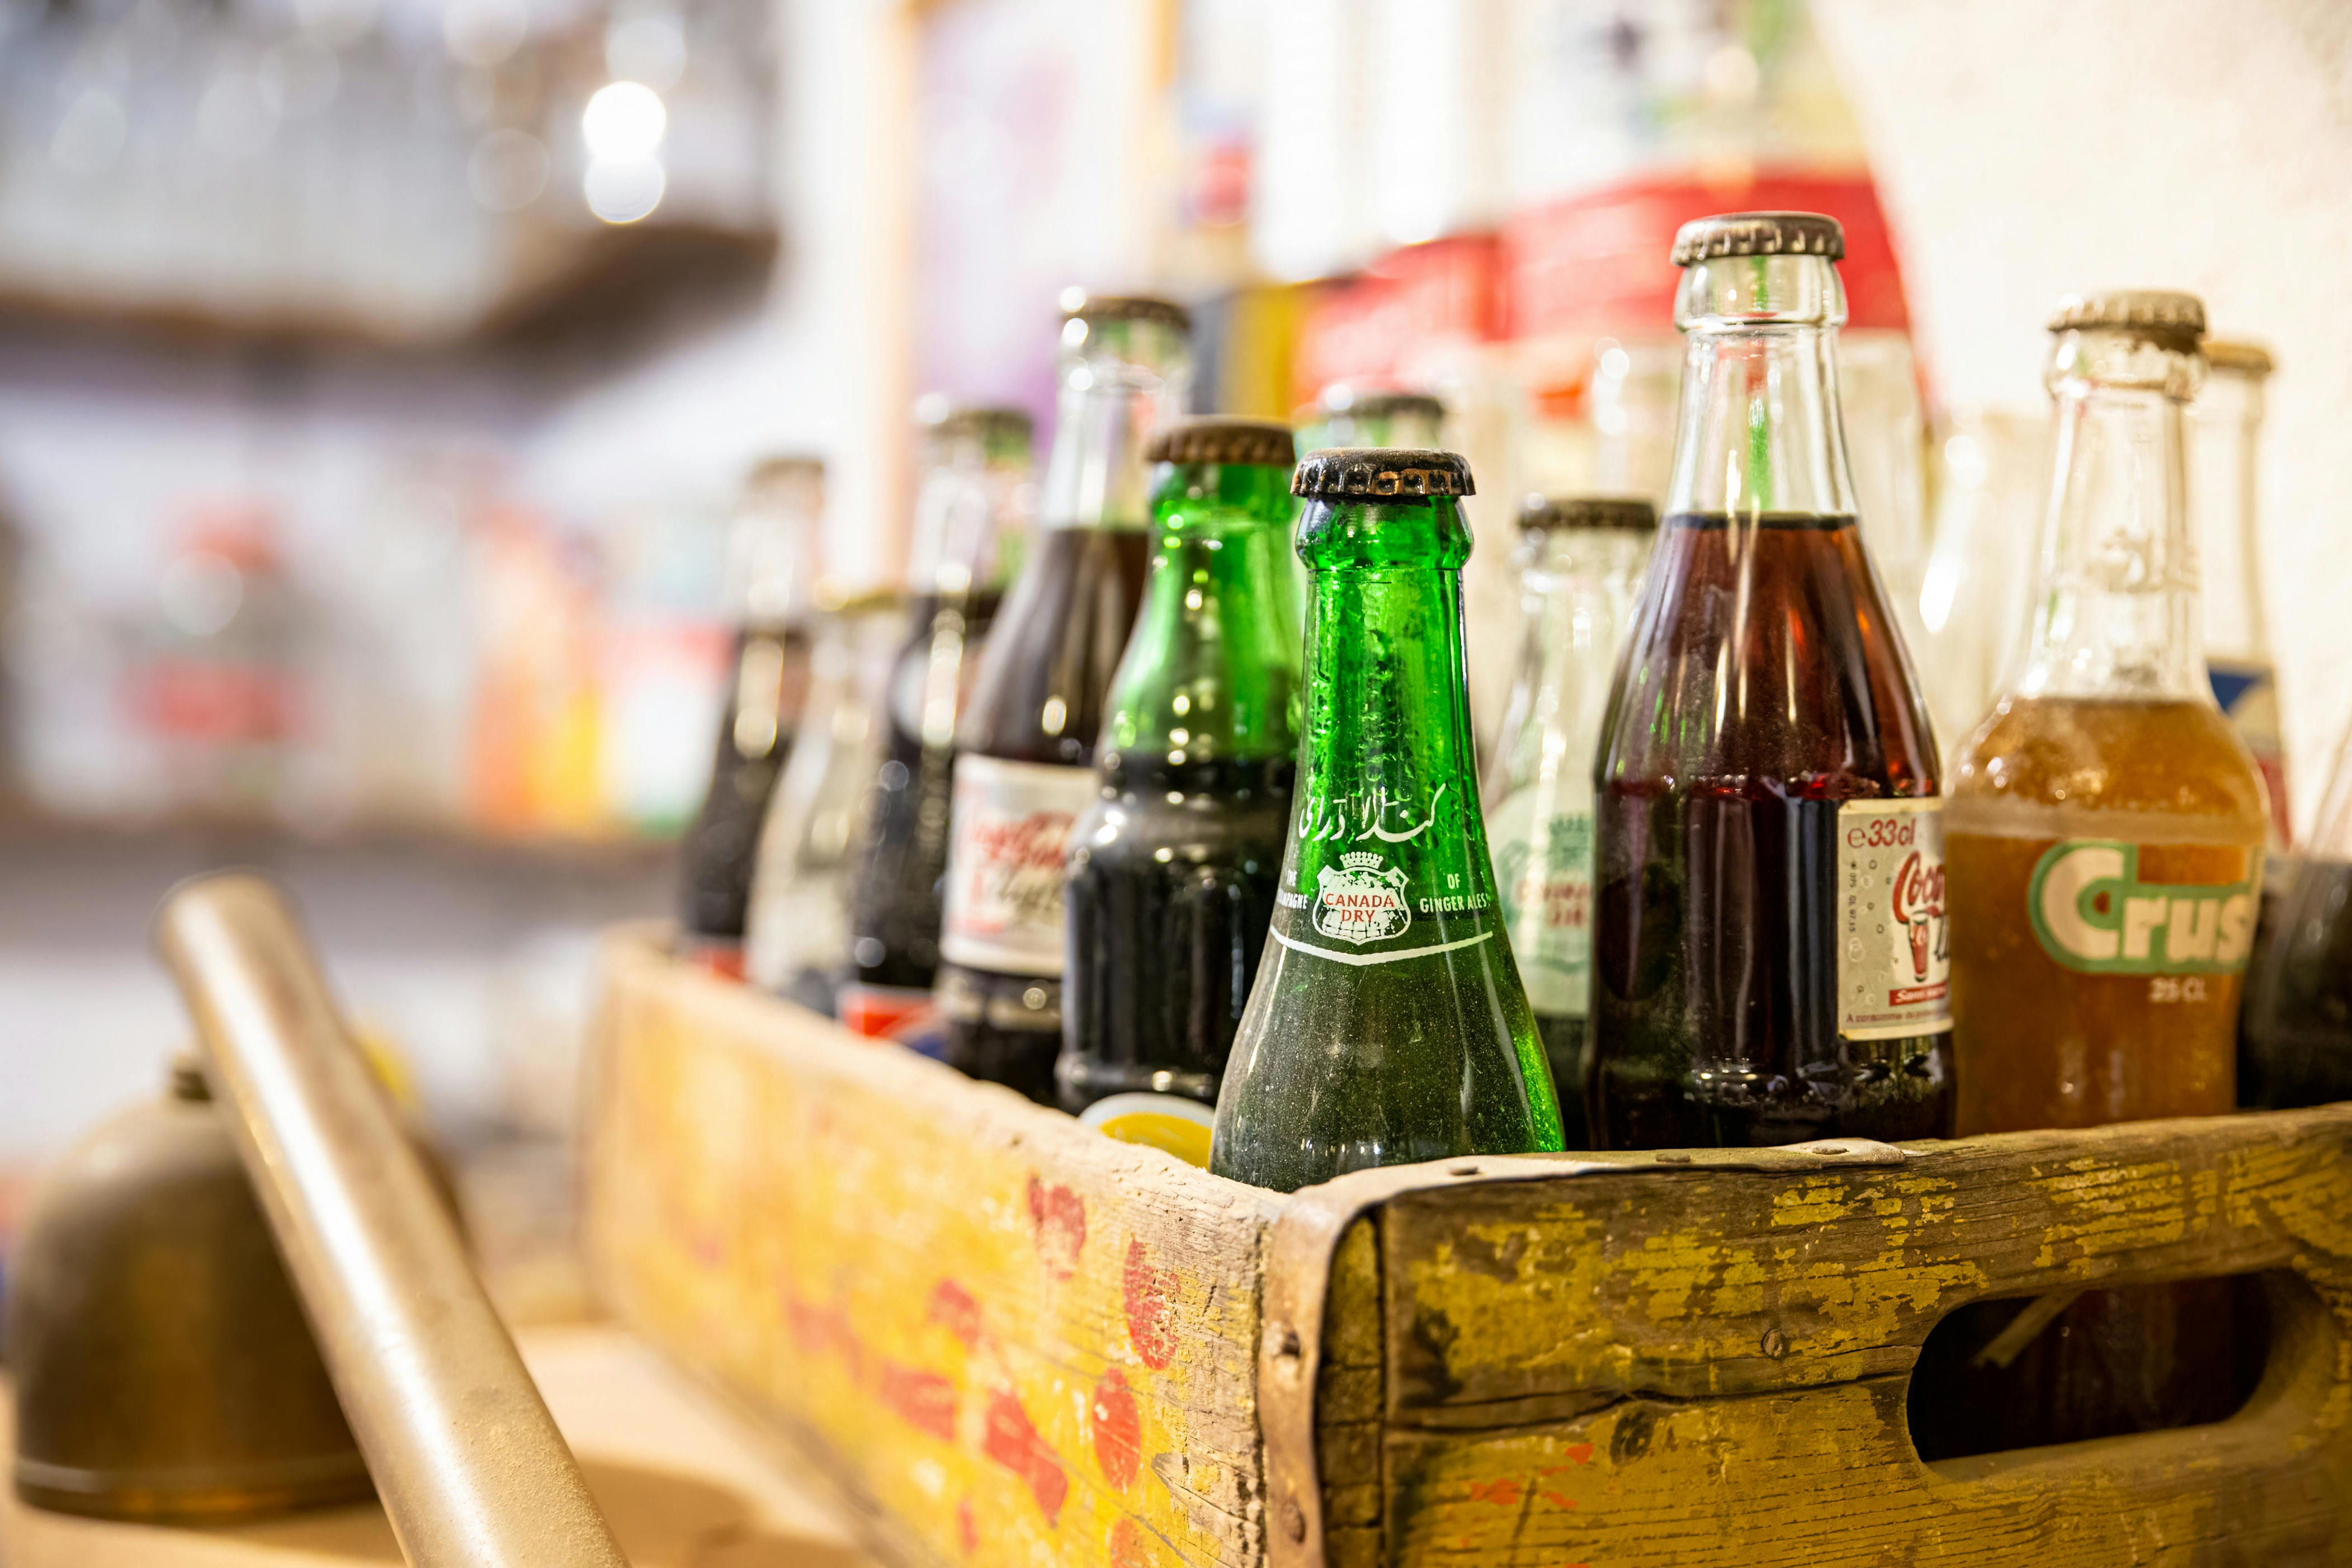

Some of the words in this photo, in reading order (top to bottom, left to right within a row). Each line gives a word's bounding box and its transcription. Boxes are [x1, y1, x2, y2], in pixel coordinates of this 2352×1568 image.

[1447, 873, 1461, 890] OF
[1325, 892, 1395, 908] CANADA
[1419, 895, 1465, 913] GINGER
[1342, 909, 1376, 923] DRY
